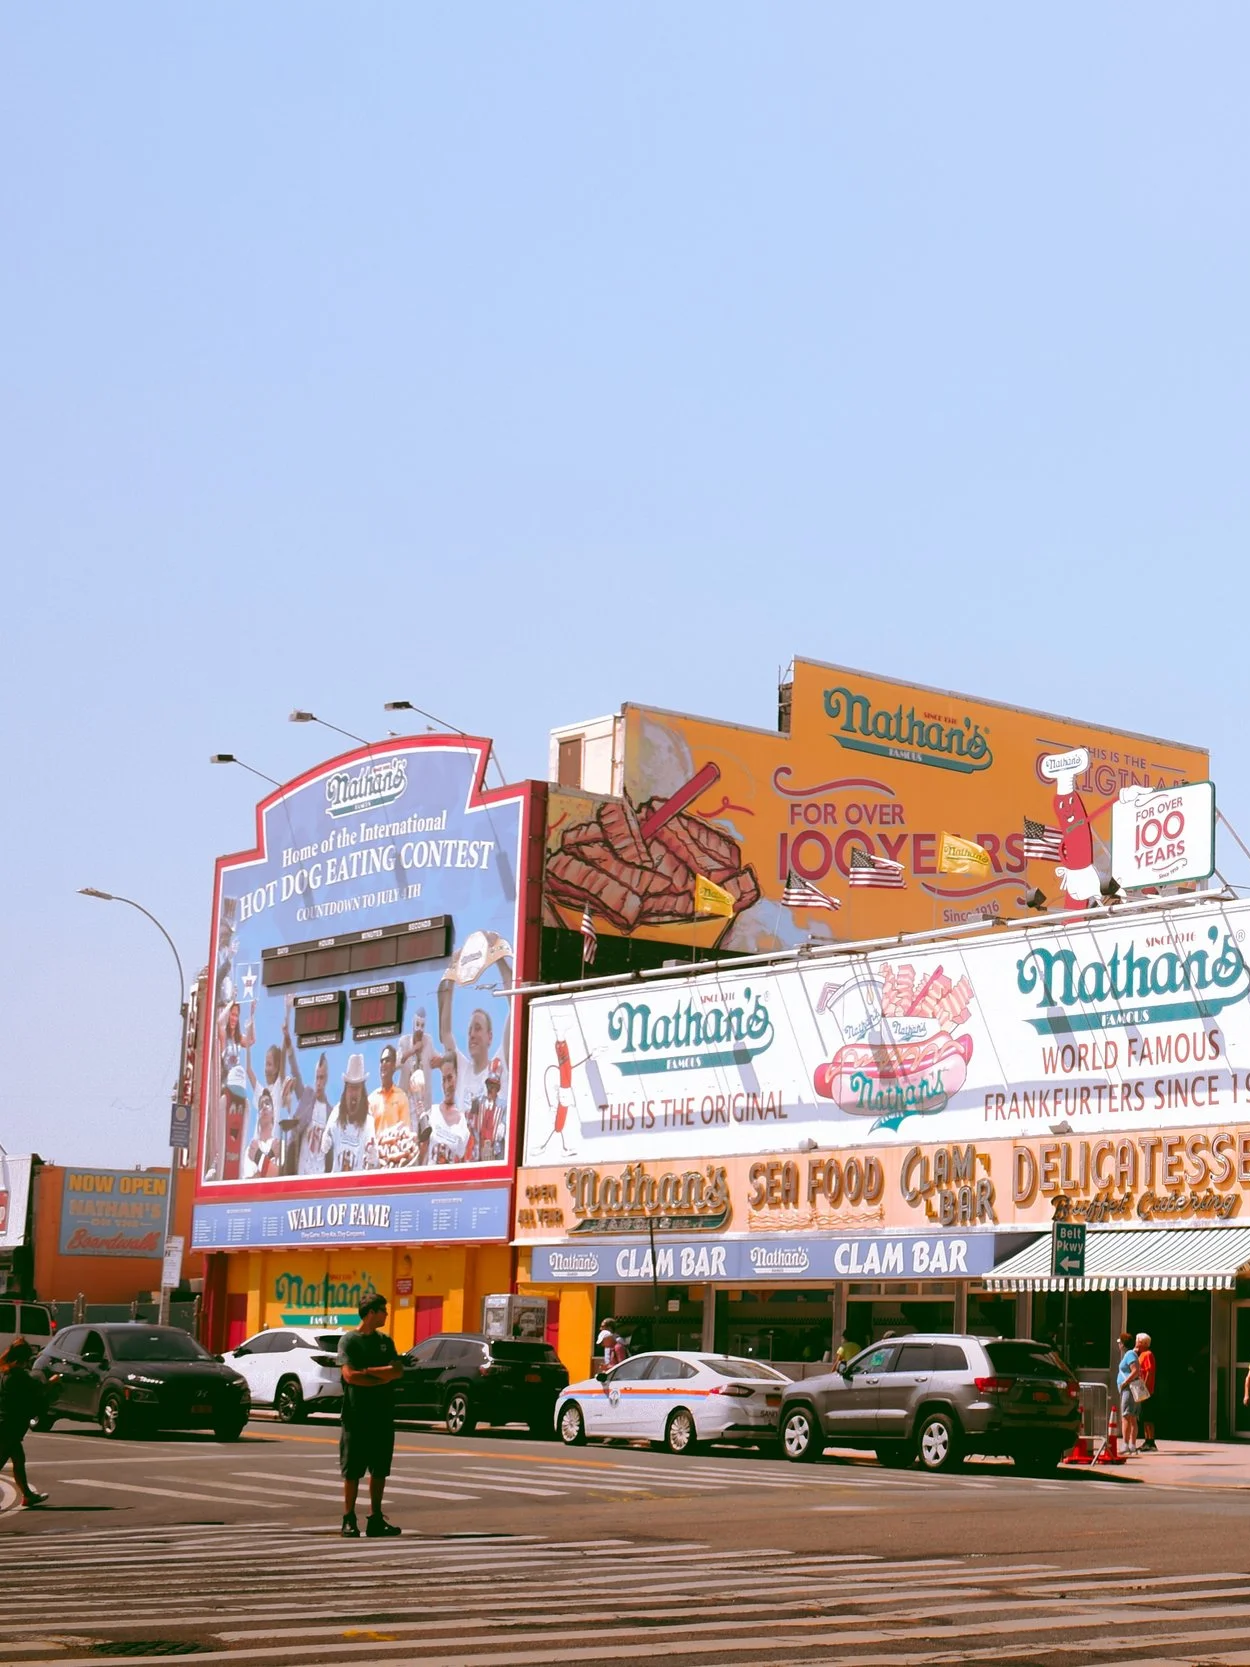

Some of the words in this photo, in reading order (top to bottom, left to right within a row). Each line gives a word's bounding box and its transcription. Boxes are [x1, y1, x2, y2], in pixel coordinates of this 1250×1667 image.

[823, 687, 988, 760] Nathan's
[1110, 752, 1121, 763] IS
[1124, 755, 1147, 769] THE
[790, 804, 836, 825] FOR
[845, 803, 905, 825] OVER
[1136, 807, 1155, 822] FOR
[1157, 797, 1184, 813] OVER
[282, 844, 318, 867] Home
[322, 831, 335, 853] of
[336, 827, 357, 848] the
[360, 810, 447, 843] International
[1135, 811, 1185, 853] 100
[876, 833, 1025, 873] YERS
[1134, 840, 1185, 869] YEARS
[240, 880, 279, 920] HOT
[281, 865, 322, 902] DOG
[325, 844, 396, 886] EATING
[400, 840, 494, 870] CONTEST
[296, 895, 360, 922] COUNTDOWN
[361, 893, 376, 909] TO
[376, 889, 399, 909] JULY
[1146, 933, 1173, 947] SINCE
[1016, 925, 1245, 1008] Nathan's
[608, 987, 769, 1053] Nathan's
[1100, 1009, 1151, 1029] FAMOUS
[666, 1056, 702, 1069] FAMOUS
[1042, 1041, 1119, 1074] WORLD
[1127, 1029, 1220, 1068] FAMOUS
[598, 1102, 635, 1131] THIS
[641, 1100, 656, 1129] IS
[661, 1097, 695, 1127] THE
[700, 1090, 788, 1124] ORIGINAL
[984, 1080, 1145, 1121] FRANKFURTERS
[1154, 1074, 1219, 1110] SINCE
[69, 1173, 114, 1193] NOW
[120, 1176, 167, 1196] OPEN
[564, 1162, 730, 1214] Nathan's
[748, 1160, 799, 1209] SEA
[807, 1156, 884, 1208] FOOD
[900, 1144, 976, 1207] CLAM
[69, 1199, 162, 1219] NATHAN'S
[286, 1205, 325, 1231] WALL
[327, 1203, 348, 1226] OF
[350, 1203, 391, 1228] FAME
[939, 1178, 999, 1225] BAR
[1051, 1192, 1136, 1222] Buffet
[1137, 1188, 1243, 1221] Catering
[1057, 1240, 1084, 1255] Pkwy
[1060, 1227, 1081, 1239] Belt
[550, 1250, 599, 1272] Nathan's
[616, 1248, 674, 1277] CLAM
[680, 1245, 727, 1277] BAR
[750, 1245, 809, 1268] Nathan's
[834, 1242, 903, 1274] CLAM
[912, 1239, 969, 1274] BAR
